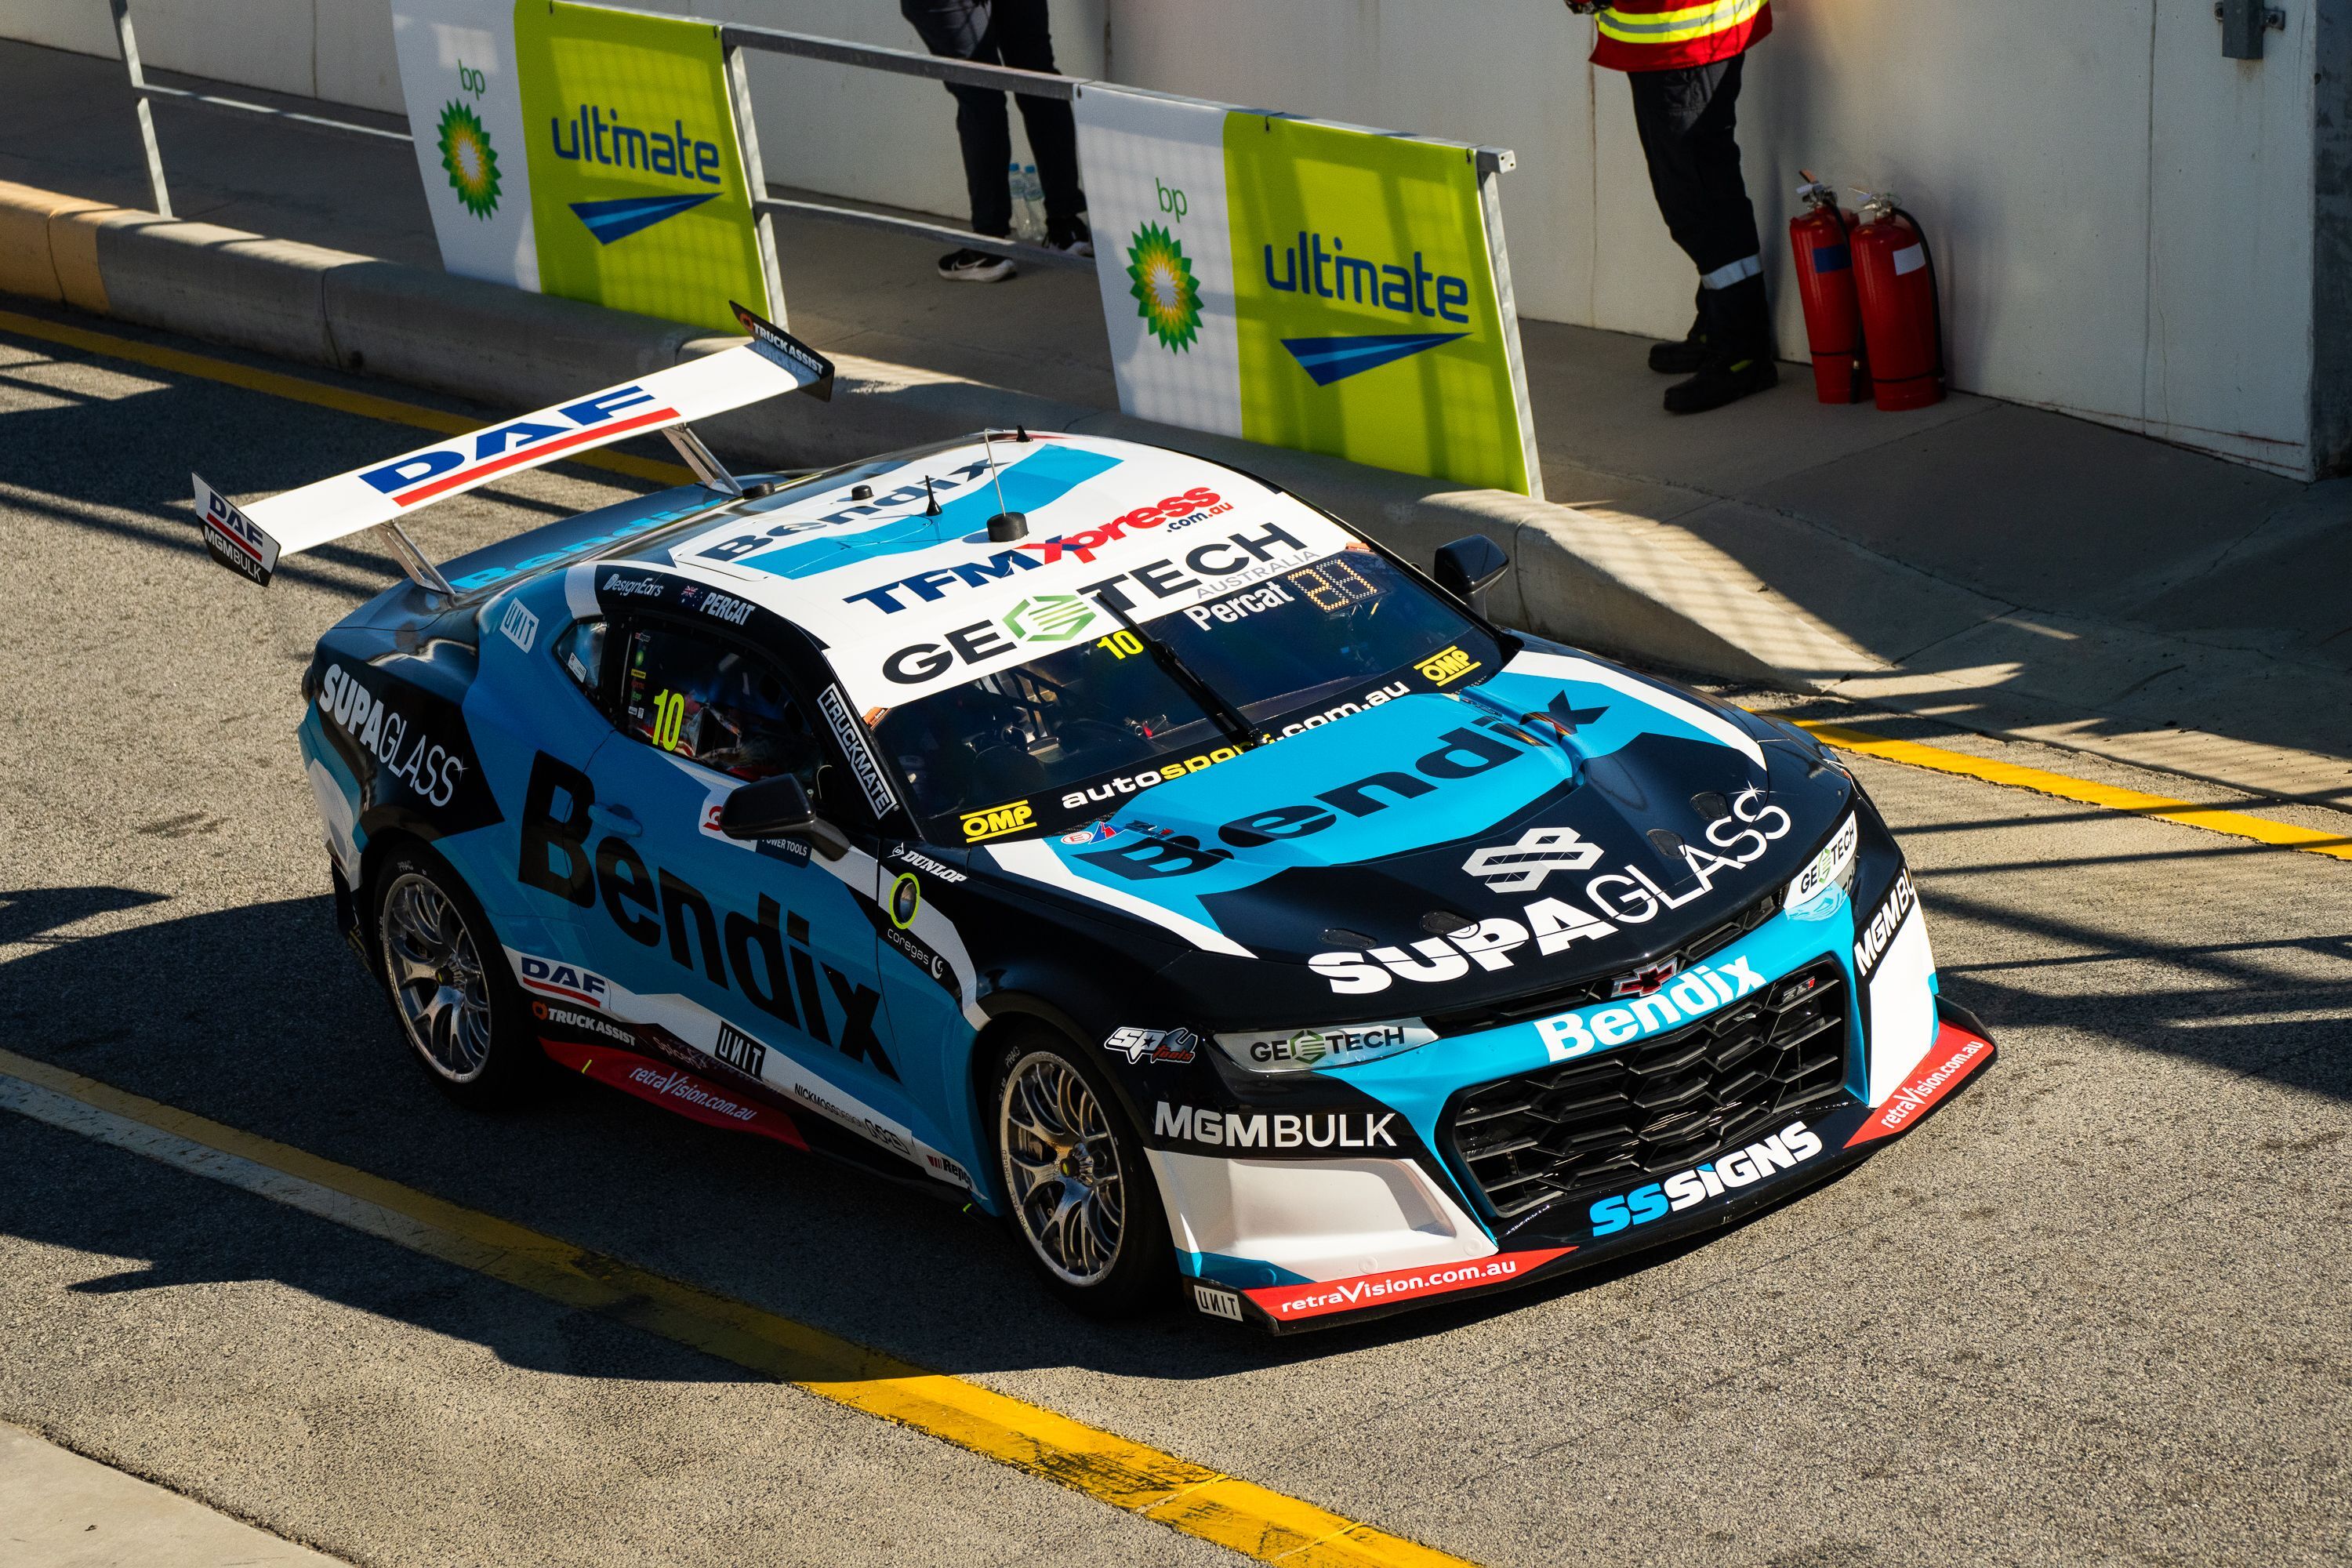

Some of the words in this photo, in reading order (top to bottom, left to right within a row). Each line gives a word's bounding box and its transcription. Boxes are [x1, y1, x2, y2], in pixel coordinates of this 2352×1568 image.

[458, 59, 486, 100] bp
[550, 103, 721, 185] ultimate
[1155, 176, 1189, 224] bp
[1263, 230, 1470, 325] ultimate
[753, 321, 789, 354] TRUCK
[789, 345, 823, 376] ASSIST
[358, 386, 657, 495] DAF
[209, 490, 263, 548] DAF
[695, 459, 1012, 562] Bendix
[204, 524, 261, 583] MGMBULK
[1196, 550, 1321, 600] AUSTRALIA
[603, 573, 665, 597] DesignEars
[700, 591, 757, 626] PERCAT
[1183, 580, 1295, 631] Percat
[1096, 630, 1145, 660] 10
[1421, 650, 1472, 683] OMP
[319, 663, 463, 807] SUPAGLASS
[653, 688, 685, 753] 10
[1073, 690, 1610, 880] Bendix
[963, 805, 1033, 837] OMP
[786, 840, 808, 857] TOOLS
[901, 850, 968, 884] DUNLOP
[518, 749, 902, 1086] Bendix
[1308, 789, 1792, 994] SUPAGLASS
[887, 927, 929, 966] coregas
[521, 956, 605, 995] DAF
[547, 1007, 596, 1031] TRUCK
[595, 1022, 636, 1047] ASSIST
[1534, 955, 1767, 1062] Bendix
[629, 1066, 757, 1122] retraVision.com.au
[1882, 1040, 1984, 1130] retraVision.com.au
[1155, 1100, 1397, 1148] MGMBULK
[1280, 1259, 1517, 1313] retraVision.com.au
